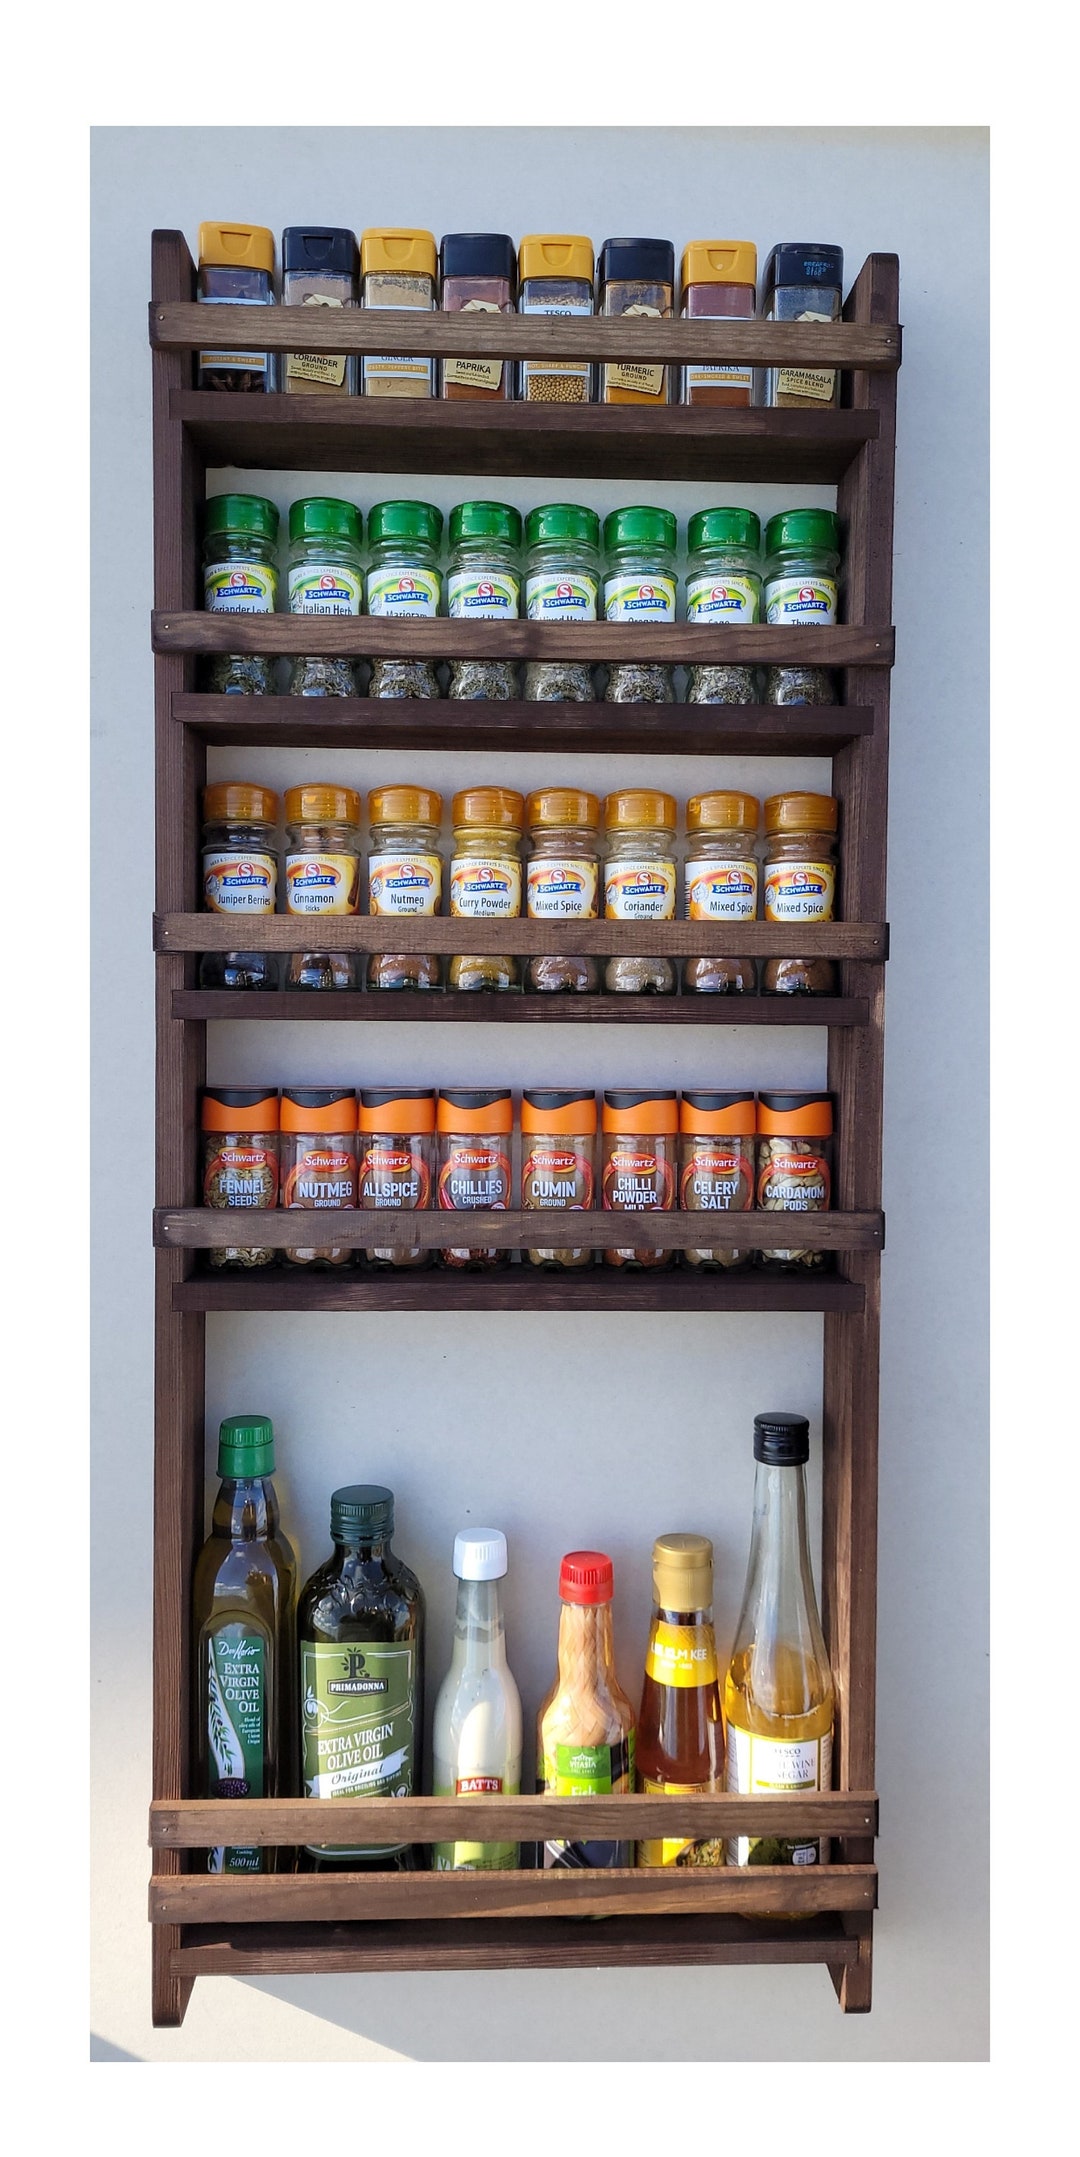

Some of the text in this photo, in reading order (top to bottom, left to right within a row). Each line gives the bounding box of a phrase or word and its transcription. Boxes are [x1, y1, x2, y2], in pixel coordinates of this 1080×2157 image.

[293, 353, 338, 368] CORIANDER
[301, 361, 328, 371] GROUND
[456, 361, 491, 374] PAPRIKA
[617, 364, 655, 377] TURMERIC
[621, 371, 647, 381] GROUND
[804, 380, 824, 388] BLEND
[219, 588, 259, 596] SCHWARTZ
[308, 590, 347, 598] SCHWARTZ
[386, 593, 425, 601] SCHWARTZ
[466, 597, 504, 605] SCHWARTZ
[545, 598, 583, 606] SCHWARTZ
[627, 600, 665, 608] SCHWARTZ
[700, 600, 737, 612] SCHWARTZ
[786, 602, 825, 611] SCHWARTZ
[302, 604, 352, 615] Italian Herb
[225, 878, 264, 886] SCHWARTZ
[295, 877, 331, 886] SCHWARTZ
[388, 879, 426, 887] SCHWARTZ
[539, 883, 577, 891] SCHWARTZ
[625, 886, 662, 894] SCHWARTZ
[715, 885, 750, 893] SCHWARTZ
[781, 886, 819, 894] SCHWARTZ
[217, 894, 271, 906] Juniper Berries
[294, 894, 334, 904] Cinnamon
[391, 894, 424, 907] Nutmeg
[459, 898, 511, 909] Curry Powder
[536, 900, 582, 912] Mixed Spice
[624, 901, 663, 912] Coriander
[709, 901, 753, 914] Mixed Spice
[776, 903, 823, 915] Mixed Spice
[221, 1152, 265, 1163] Schwartz
[305, 1156, 348, 1166] Schwartz
[367, 1154, 409, 1165] Schwartz
[454, 1153, 497, 1164] Schwartz
[532, 1155, 575, 1166] Schwartz
[612, 1157, 654, 1167] Schwartz
[695, 1157, 738, 1167] Schwartz
[774, 1159, 817, 1169] Schwartz
[219, 1180, 266, 1194] FENNEL
[299, 1181, 352, 1198] NUTMEG
[363, 1182, 418, 1197] ALLSPICE
[451, 1180, 502, 1195] CHILLIES
[531, 1181, 576, 1198] CUMIN
[617, 1178, 652, 1190] CHILLI
[694, 1181, 738, 1195] CELERY
[613, 1190, 657, 1203] POWDER
[766, 1186, 824, 1199] CARDAMOM
[228, 1195, 259, 1206] SEEDS
[314, 1199, 341, 1207] GROUND
[375, 1198, 401, 1207] GROUND
[462, 1196, 492, 1204] CRUSHED
[539, 1199, 566, 1207] GROUND
[701, 1196, 732, 1209] SALT
[783, 1200, 808, 1210] PODS
[690, 1648, 707, 1661] KEE
[224, 1662, 260, 1674] EXTRA
[220, 1676, 260, 1688] VIRGIN
[330, 1682, 384, 1692] PRIMADONNA
[225, 1688, 260, 1700] OLIVE
[239, 1701, 260, 1713] OIL
[317, 1721, 394, 1755] EXTRA VIRGIN
[327, 1744, 383, 1770] OLIVE OIL
[332, 1763, 384, 1785] Original
[461, 1778, 498, 1792] BATTS
